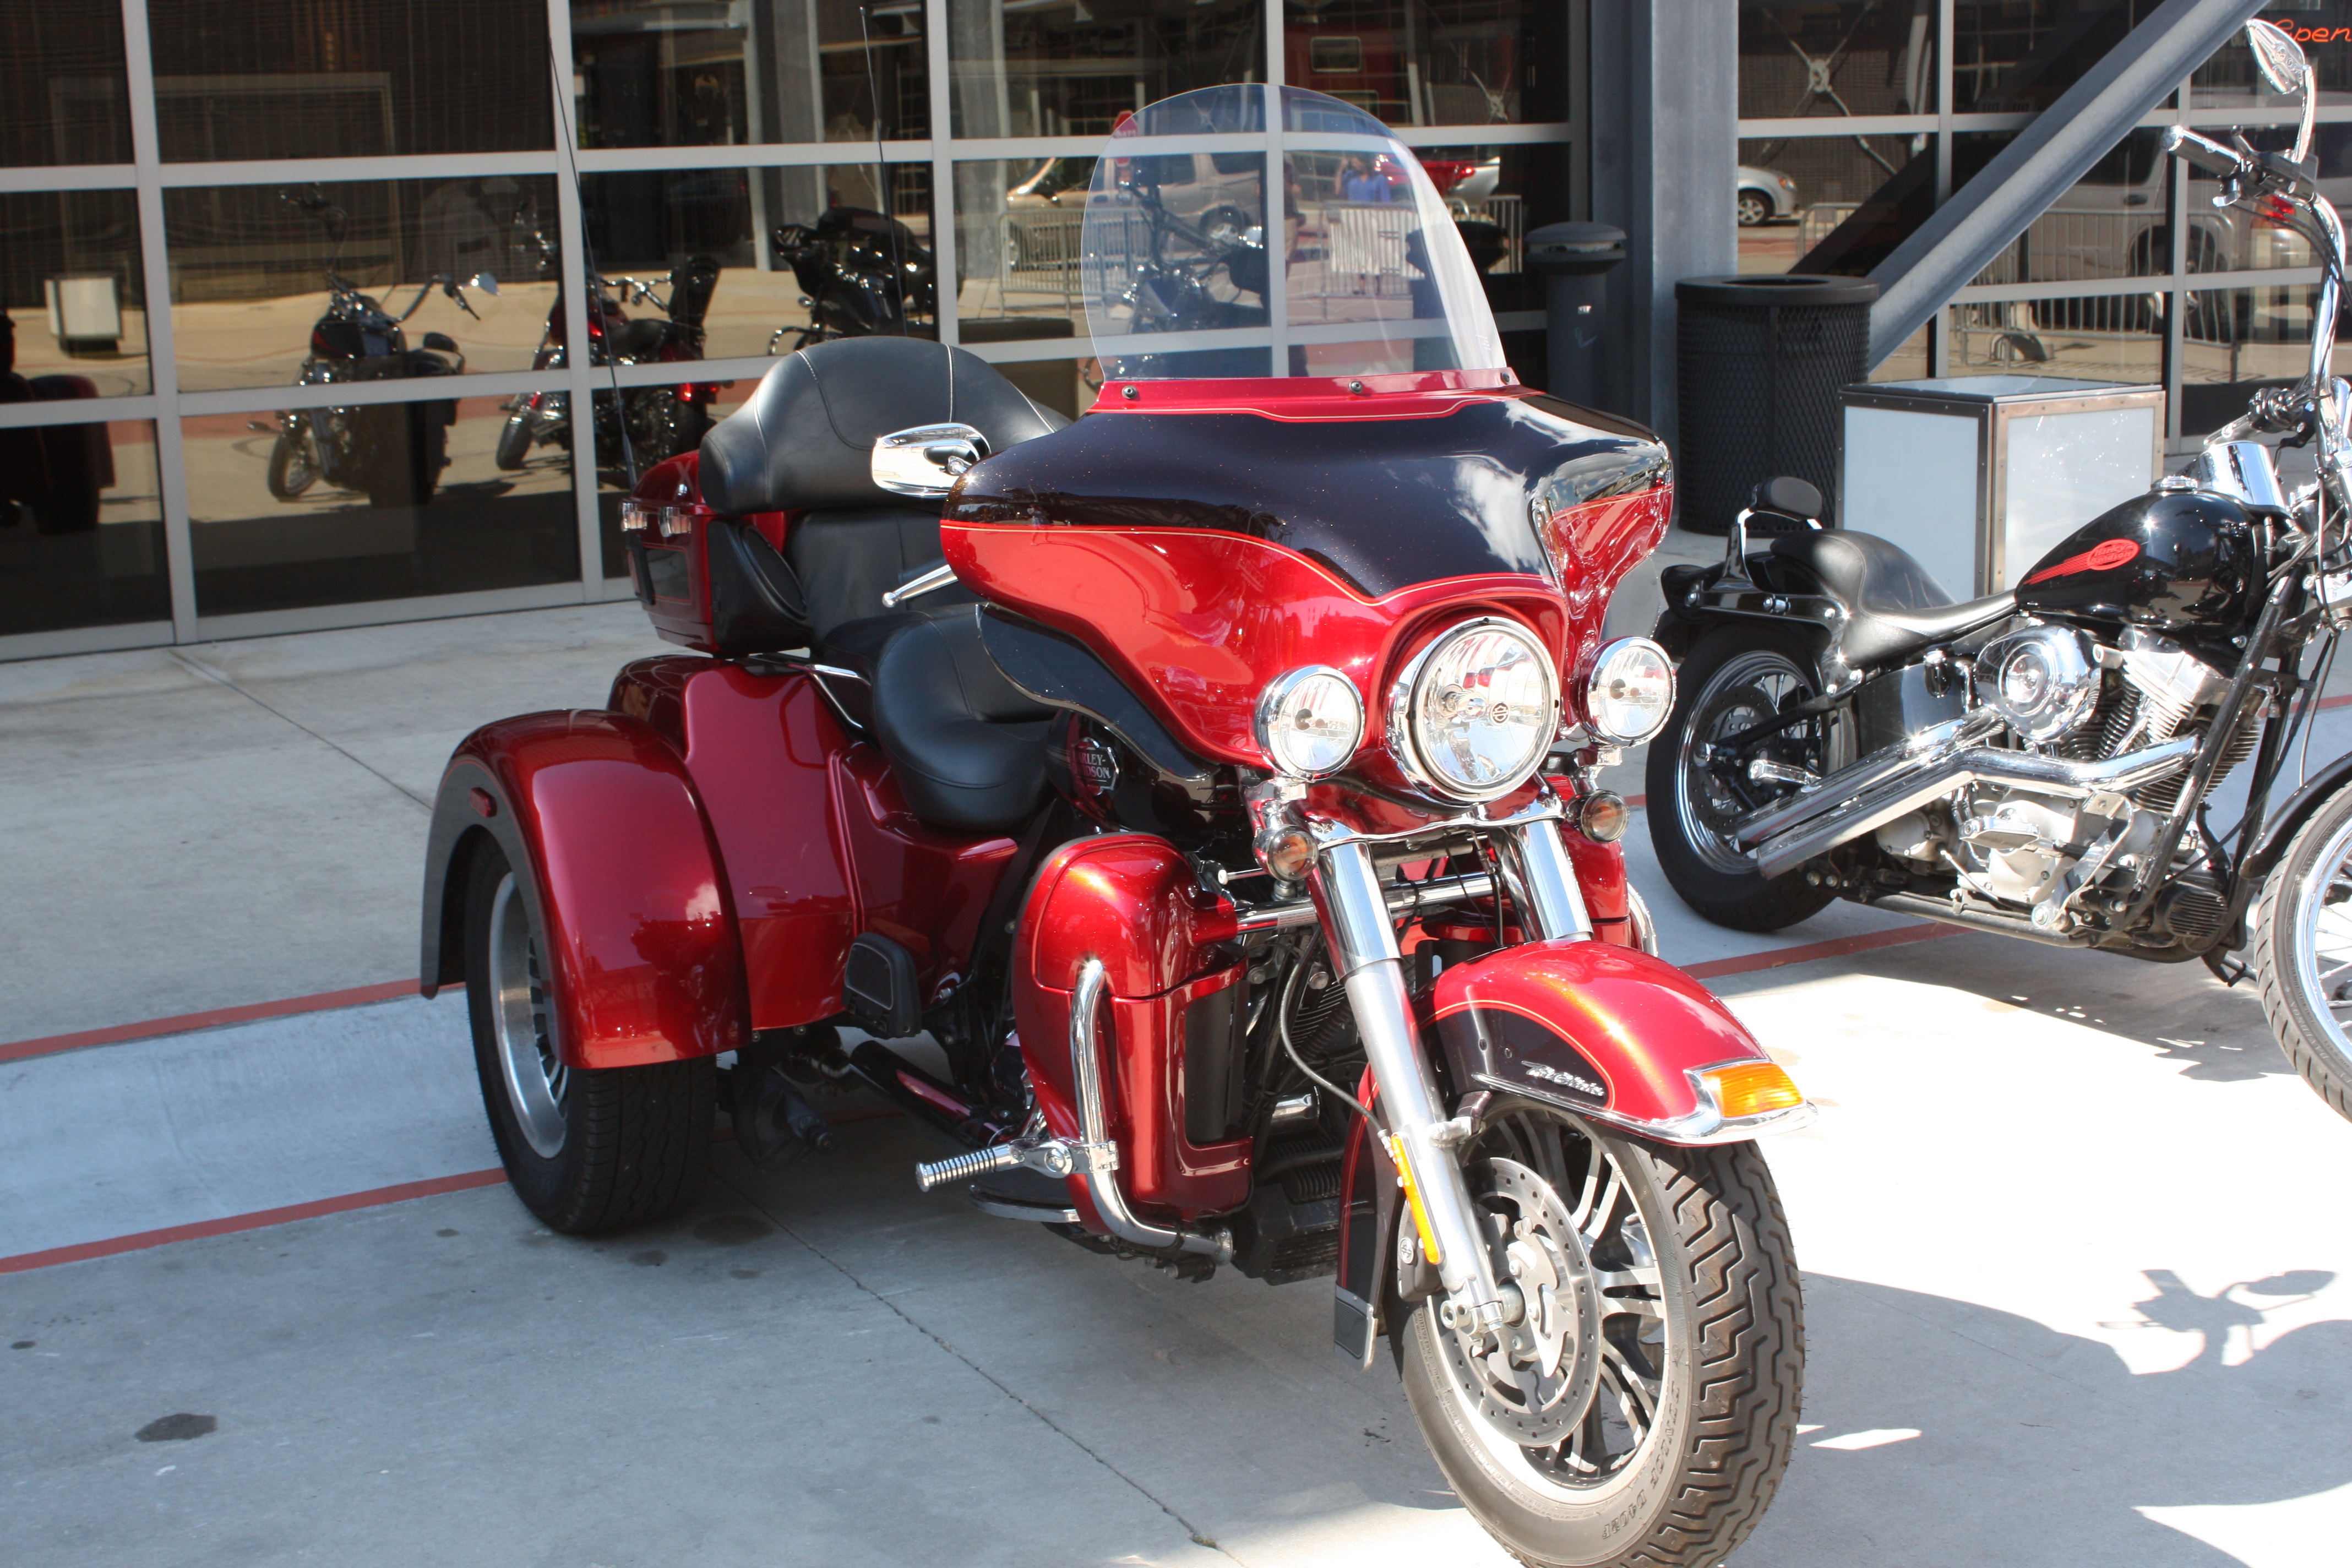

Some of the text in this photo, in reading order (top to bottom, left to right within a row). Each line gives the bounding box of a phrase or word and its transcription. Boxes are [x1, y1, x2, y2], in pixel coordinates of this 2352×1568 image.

[1072, 752, 1106, 766] RLEY-
[1072, 761, 1111, 778] IDSON
[1602, 1488, 1647, 1540] D402F
